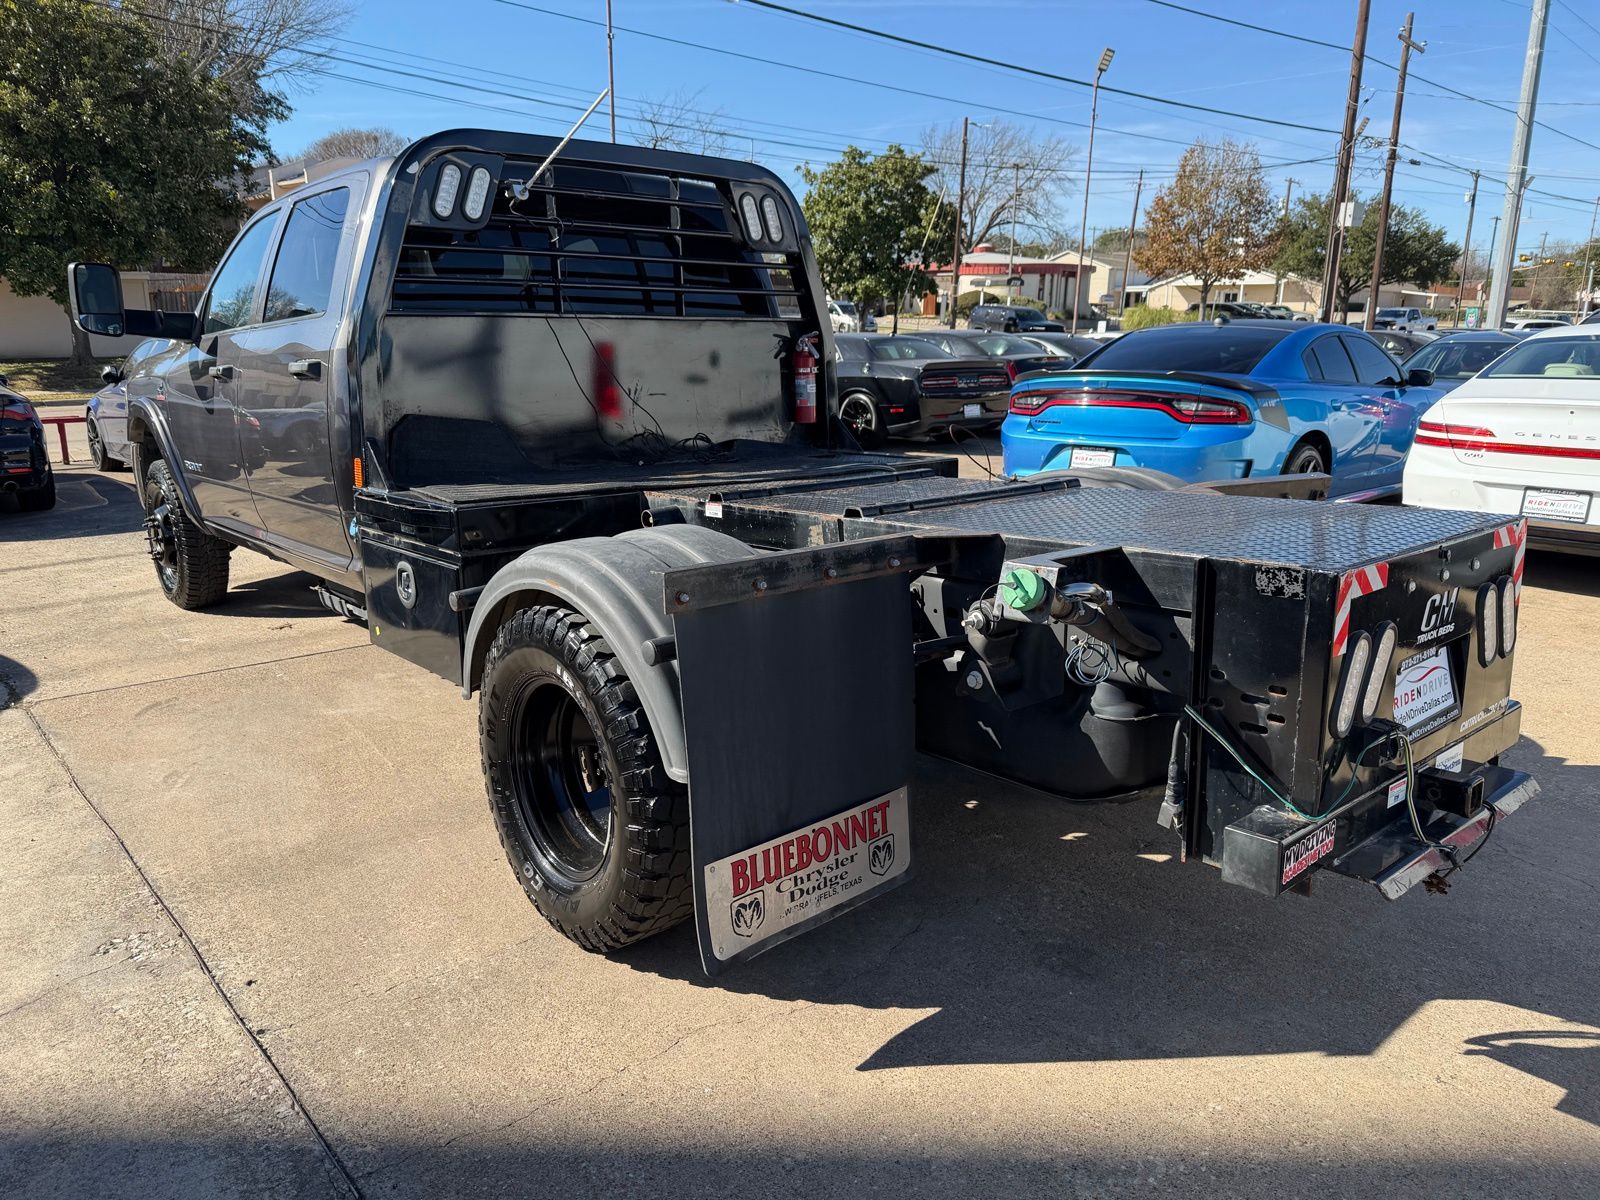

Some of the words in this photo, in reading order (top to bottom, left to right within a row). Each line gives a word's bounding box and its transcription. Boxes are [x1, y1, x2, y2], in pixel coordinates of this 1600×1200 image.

[1527, 499, 1585, 511] RIDENDRIVE
[1416, 629, 1439, 646] TRUCK
[1438, 622, 1456, 637] BEDS
[1392, 673, 1449, 710] RIDENDRIVE
[731, 799, 891, 898] BLUEBONNET
[1284, 843, 1300, 871] MY
[1299, 818, 1337, 860] DRIVING
[775, 851, 859, 894] Chrysler
[789, 870, 849, 903] Dodge
[840, 876, 863, 892] TEXAS
